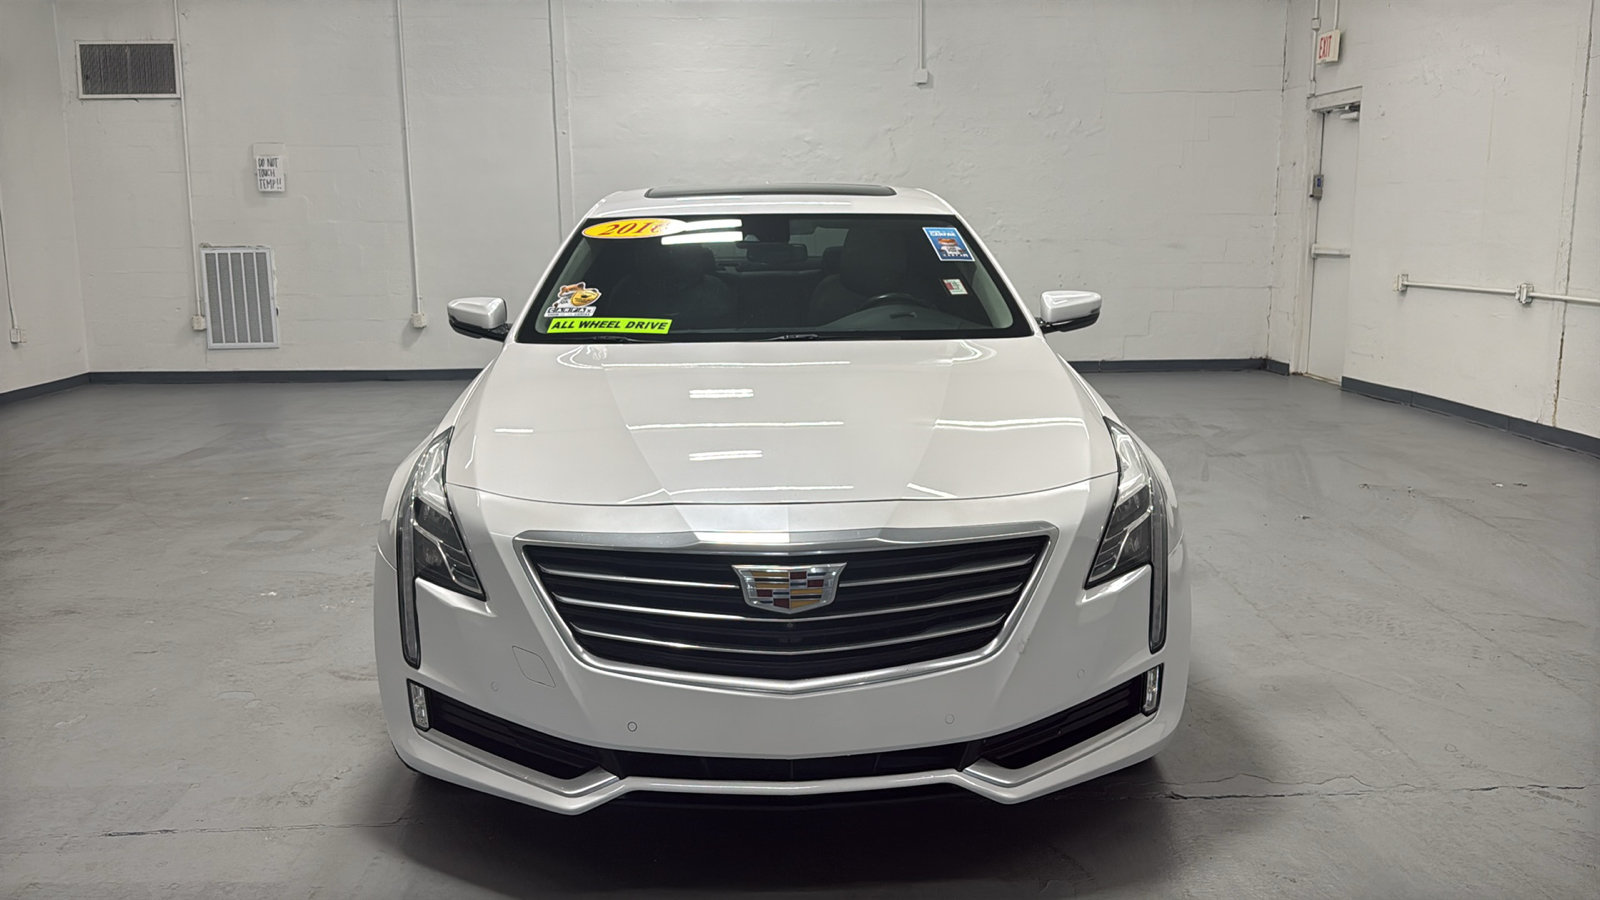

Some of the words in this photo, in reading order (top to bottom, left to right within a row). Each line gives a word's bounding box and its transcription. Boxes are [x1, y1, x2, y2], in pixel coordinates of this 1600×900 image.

[1319, 35, 1332, 59] EXIT
[258, 158, 265, 168] DO
[267, 158, 279, 168] NOT
[258, 169, 275, 178] TOUCH
[551, 321, 575, 330] ALL
[578, 320, 621, 329] WHEEL
[625, 321, 668, 330] DRIVE
